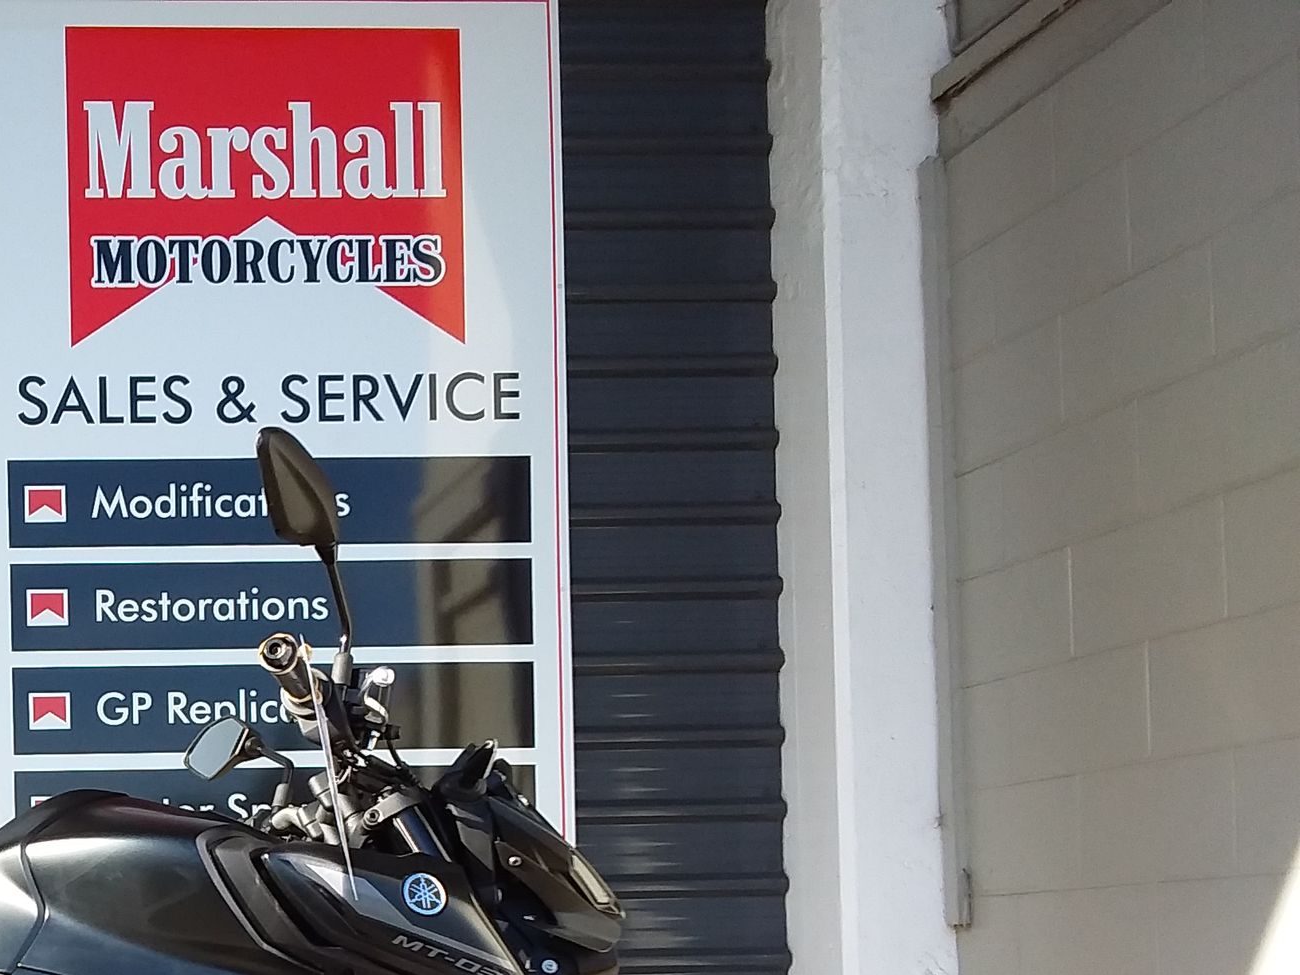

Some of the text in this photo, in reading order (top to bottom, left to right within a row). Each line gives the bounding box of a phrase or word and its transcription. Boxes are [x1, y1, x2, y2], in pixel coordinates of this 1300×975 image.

[83, 100, 447, 200] Marshall
[91, 235, 445, 287] MOTORCYCLES
[17, 371, 522, 426] SALES & SERVICE
[91, 482, 352, 520] Modificats
[95, 587, 329, 625] Restorations
[96, 691, 152, 726] GP
